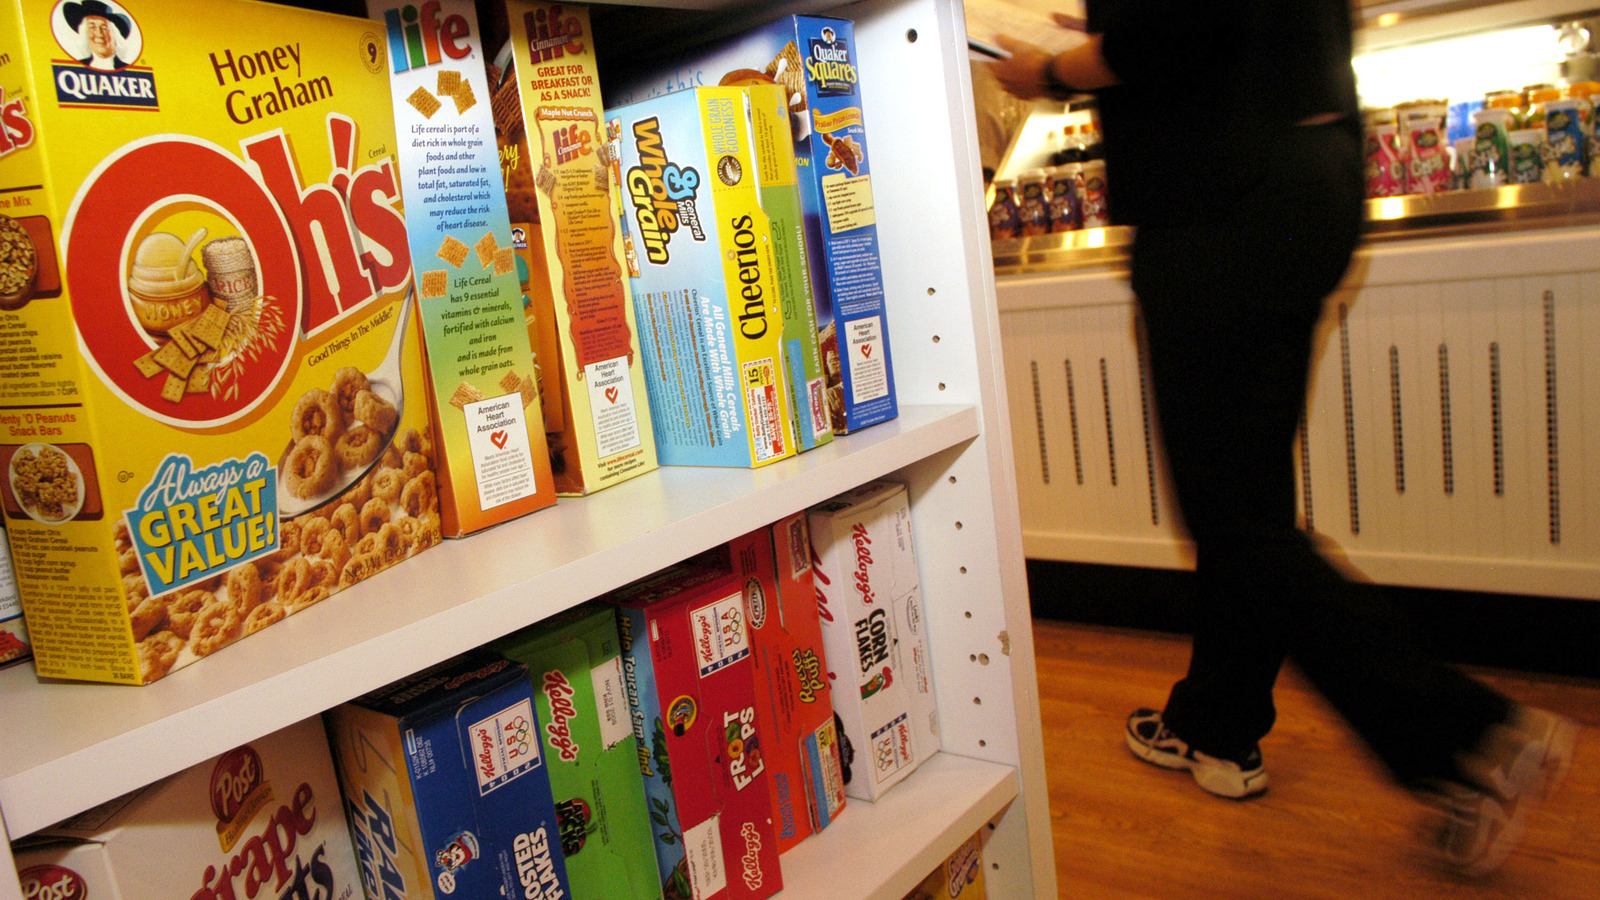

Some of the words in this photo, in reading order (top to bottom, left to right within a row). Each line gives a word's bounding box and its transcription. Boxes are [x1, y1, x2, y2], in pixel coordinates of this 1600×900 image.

[384, 0, 472, 75] life
[523, 5, 585, 65] life
[531, 35, 569, 52] Cinnamon
[210, 42, 301, 87] Honey
[367, 42, 378, 64] 9
[813, 45, 848, 62] Quaker
[531, 76, 580, 90] BREAKFAST
[581, 75, 593, 85] OR
[537, 65, 565, 77] GREAT
[568, 64, 584, 75] FOR
[667, 68, 704, 92] this
[805, 57, 857, 88] Squares
[58, 69, 156, 99] QUAKER
[540, 91, 553, 102] AS
[554, 90, 561, 100] A
[562, 87, 592, 100] SNACK!
[225, 75, 334, 125] Graham
[541, 108, 560, 117] Maple
[562, 108, 572, 116] Nut
[573, 108, 593, 117] Crunch
[707, 98, 722, 127] GRAIN
[815, 119, 833, 129] Praline
[832, 115, 846, 126] Pecan
[846, 112, 861, 121] Crunch
[411, 124, 425, 135] Life
[426, 125, 446, 133] cereal
[447, 125, 453, 133] is
[453, 125, 467, 135] part
[468, 124, 475, 135] of
[720, 98, 739, 154] GOODNESS!
[368, 144, 387, 159] Cereal
[412, 138, 425, 147] diet
[427, 138, 440, 147] rich
[440, 138, 447, 147] in
[448, 138, 466, 147] whole
[467, 138, 483, 149] grain
[553, 124, 593, 165] life
[557, 142, 583, 155] Cinnamon
[711, 127, 726, 155] WHOLE
[426, 152, 444, 163] foods
[446, 152, 458, 160] and
[459, 151, 475, 160] other
[418, 167, 436, 178] plant
[438, 166, 455, 176] foods
[456, 165, 468, 174] and
[469, 165, 479, 173] low
[480, 165, 486, 173] in
[633, 116, 679, 233] Whole
[418, 180, 435, 189] total
[436, 180, 448, 191] fat,
[449, 179, 479, 188] saturated
[480, 178, 491, 188] fat,
[13, 196, 32, 207] Mix
[423, 194, 437, 203] and
[438, 192, 472, 202] cholesterol
[473, 191, 490, 201] which
[430, 209, 444, 219] may
[445, 206, 466, 216] reduce
[467, 205, 477, 214] the
[479, 205, 490, 213] risk
[627, 166, 669, 264] Grain
[677, 201, 690, 225] Mills
[684, 199, 706, 241] General
[437, 222, 444, 232] of
[444, 220, 462, 230] heart
[464, 219, 488, 228] disease.
[795, 225, 806, 266] SCHOOL!
[215, 275, 252, 294] RICE
[454, 278, 468, 289] Life
[469, 274, 491, 286] Cereal
[731, 215, 768, 340] Cheerios
[801, 269, 810, 295] YOUR
[450, 294, 463, 303] has
[464, 292, 469, 302] 9
[470, 288, 499, 300] essential
[700, 296, 710, 315] Are
[805, 298, 813, 317] FOR
[145, 296, 202, 321] HONEY
[441, 308, 472, 320] vitamins
[472, 305, 480, 315] &
[481, 301, 512, 314] minerals,
[712, 304, 724, 320] All
[443, 322, 474, 337] fortified
[475, 319, 489, 329] with
[490, 316, 514, 326] calcium
[696, 318, 705, 337] Cereal
[703, 315, 715, 347] Made
[808, 320, 817, 344] CASH
[853, 322, 873, 331] American
[859, 329, 870, 337] Heart
[308, 346, 330, 367] Good
[328, 336, 351, 354] Things
[350, 330, 359, 341] In
[357, 325, 370, 337] The
[469, 335, 482, 345] and
[483, 334, 497, 342] iron
[700, 344, 706, 352] an
[715, 321, 732, 364] General
[852, 335, 877, 344] Association
[457, 351, 471, 362] and
[472, 350, 477, 359] is
[478, 348, 497, 358] made
[498, 345, 513, 357] from
[708, 346, 721, 373] With
[812, 347, 821, 373] EARN
[459, 364, 480, 376] whole
[481, 362, 498, 375] grain
[499, 359, 514, 369] oats.
[595, 361, 619, 372] American
[601, 369, 615, 378] Heart
[702, 353, 712, 381] Excellent
[723, 365, 735, 391] Mills
[748, 367, 759, 385] 15
[594, 375, 624, 388] Association
[707, 381, 716, 402] Source
[713, 375, 726, 409] Whole
[0, 414, 20, 427] lenty
[36, 413, 77, 424] Peanuts
[478, 401, 510, 415] American
[486, 411, 505, 421] Heart
[712, 410, 720, 430] Whole
[726, 393, 741, 432] Cereals
[10, 426, 38, 437] Snack
[40, 425, 63, 436] Bars
[477, 417, 516, 433] Association
[719, 408, 731, 439] Grain
[607, 449, 644, 466] www.lifecereal.com
[614, 463, 623, 471] more
[624, 458, 637, 468] recipes
[600, 470, 620, 481] containing
[620, 464, 637, 474] Cinnamon
[637, 460, 645, 468] Life!
[144, 461, 244, 510] Always
[246, 461, 264, 479] a
[138, 477, 268, 548] GREAT
[145, 511, 275, 585] VALUE!
[345, 563, 363, 582] Net
[852, 522, 874, 605] Kellogg's
[620, 616, 632, 652] Help
[698, 615, 713, 663] Kellogg's
[869, 608, 890, 664] CORN
[803, 648, 825, 690] Puffs
[604, 679, 612, 695] NOV
[625, 656, 640, 708] Toucan
[543, 670, 579, 761] Kellogg's
[632, 710, 644, 740] Sam
[494, 718, 504, 745] SPONSOR
[740, 706, 765, 778] LOOPS
[818, 731, 828, 750] 20
[897, 722, 909, 761] Kellogg's
[478, 728, 496, 779] Kellogg's
[498, 745, 508, 772] OFFICIAL
[638, 746, 653, 777] find
[723, 711, 752, 792] FROOT
[217, 754, 257, 817] Post
[774, 773, 785, 804] Cereal
[781, 773, 790, 800] Value
[513, 833, 545, 900] OSTED
[529, 827, 565, 900] FLAKES
[740, 822, 763, 891] Kellogg's
[22, 874, 74, 900] Post
